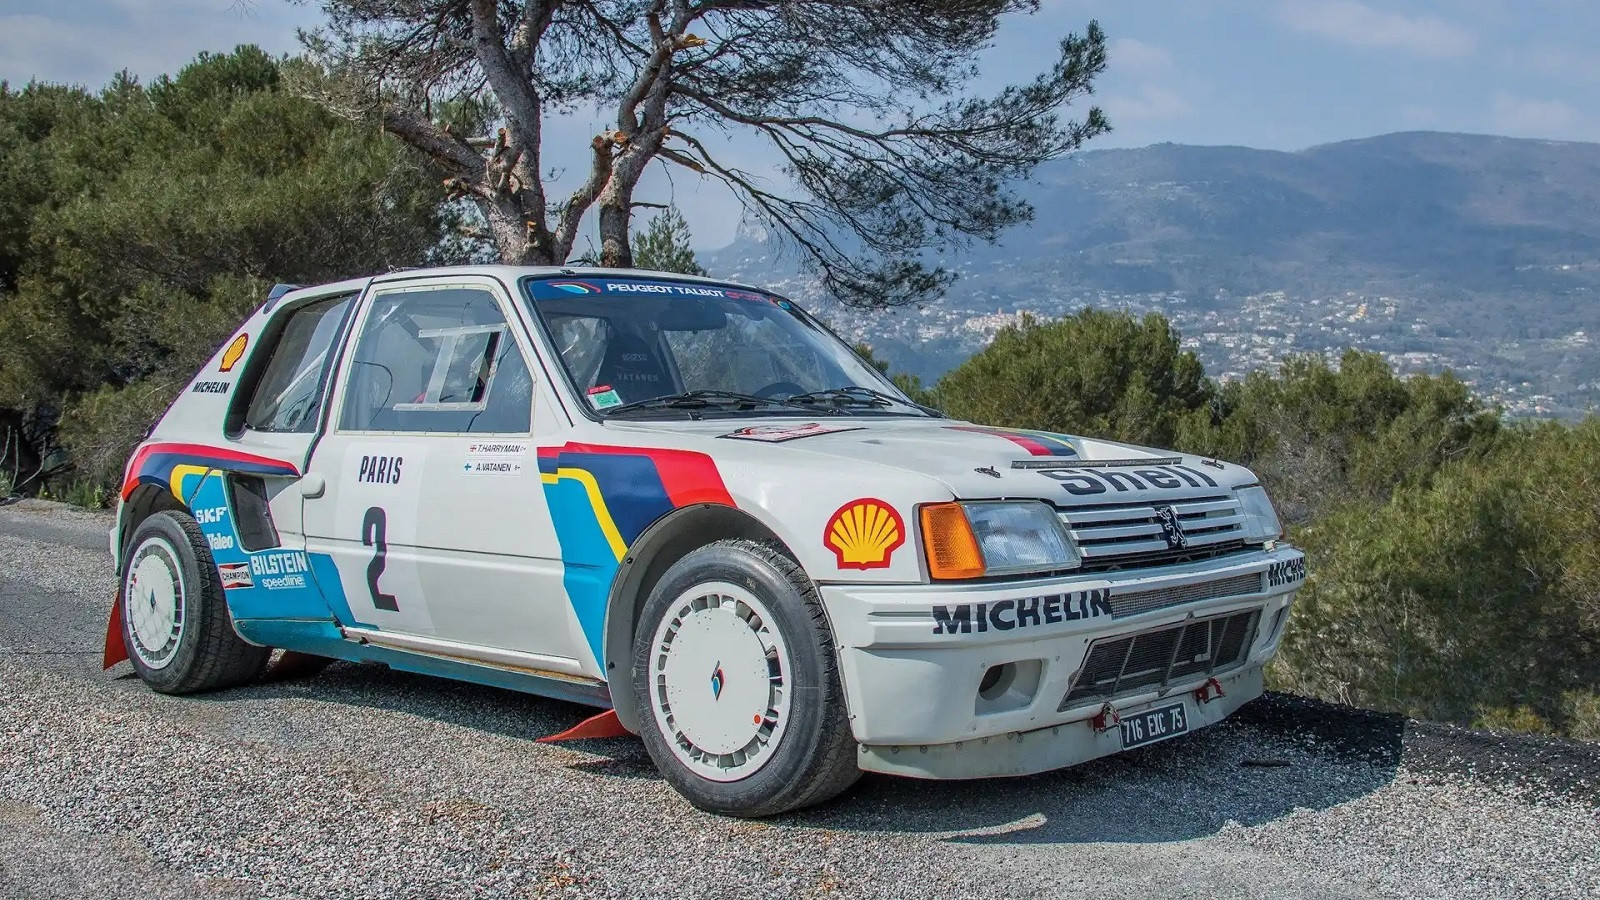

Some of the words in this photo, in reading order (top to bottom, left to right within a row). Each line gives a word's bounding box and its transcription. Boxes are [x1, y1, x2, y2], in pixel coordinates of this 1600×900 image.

[606, 283, 673, 294] PEUGEOT
[674, 287, 725, 298] TALBOT
[192, 381, 230, 394] MICHELIN
[359, 455, 403, 485] PARIS
[1036, 465, 1218, 495] Shell
[195, 506, 227, 524] SKF
[250, 551, 308, 576] BILSTEIN
[362, 506, 400, 613] 2
[221, 571, 251, 581] CHAMPION
[262, 575, 303, 590] speedline
[932, 587, 1113, 635] MICHELIN
[1123, 718, 1143, 743] 716
[1146, 712, 1166, 737] EXC
[1169, 707, 1183, 730] 75
